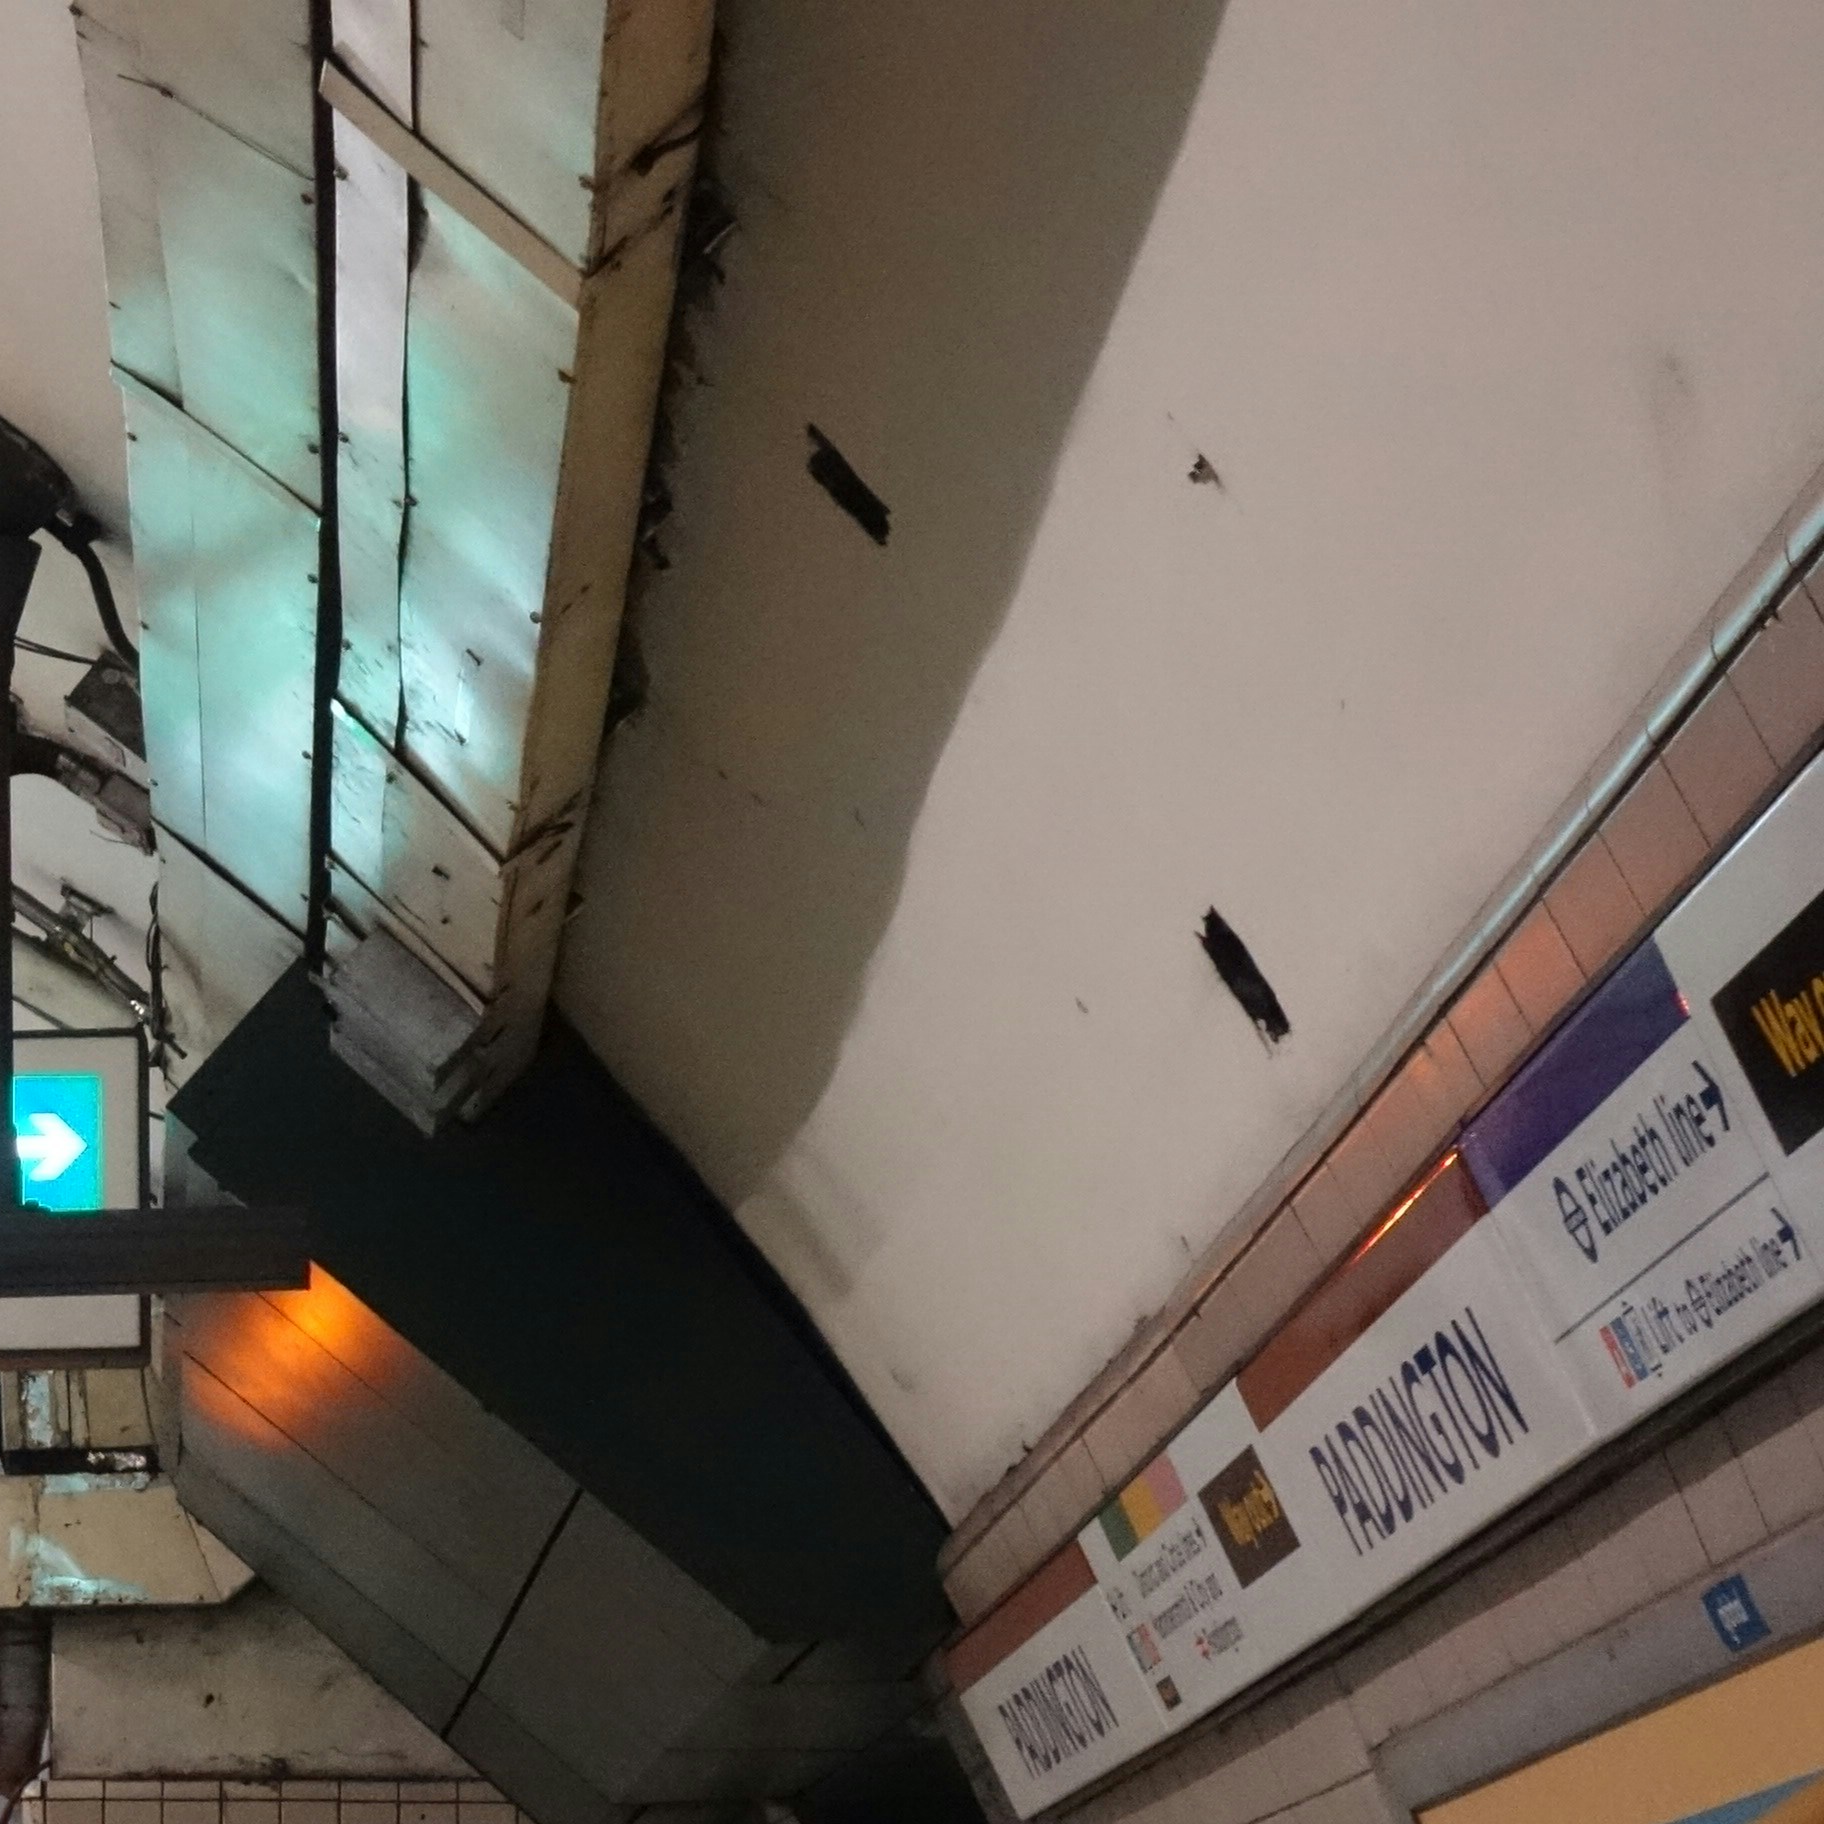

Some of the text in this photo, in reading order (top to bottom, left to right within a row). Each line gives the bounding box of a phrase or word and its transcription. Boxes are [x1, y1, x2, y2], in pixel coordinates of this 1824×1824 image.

[1575, 1094, 1715, 1236] Elizabeth line
[1309, 1306, 1530, 1556] PADDINGTON
[998, 1645, 1119, 1781] PADDINGTON
